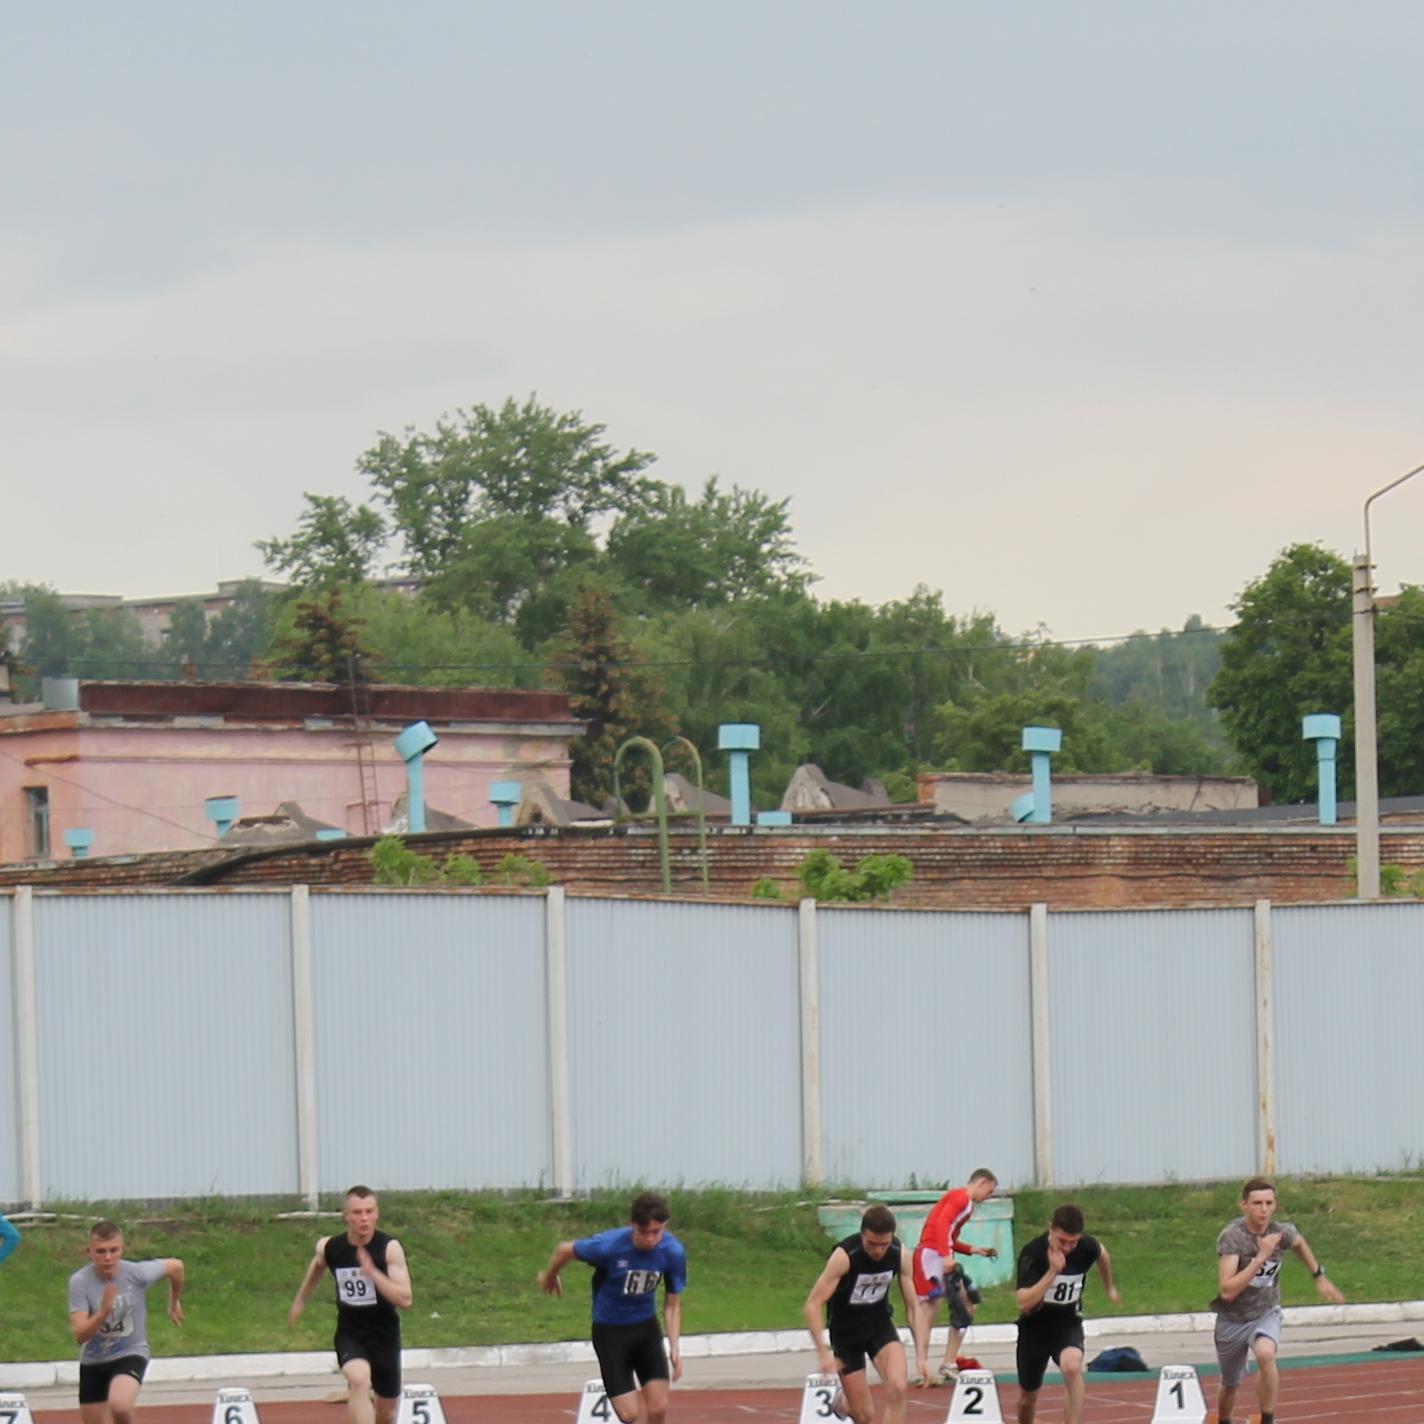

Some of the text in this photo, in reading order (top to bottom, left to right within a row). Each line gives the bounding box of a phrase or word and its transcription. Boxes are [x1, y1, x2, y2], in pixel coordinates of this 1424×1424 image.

[345, 1280, 366, 1297] 99
[861, 1283, 882, 1297] 77
[1054, 1282, 1075, 1301] 81
[591, 1394, 611, 1422] 4
[816, 1389, 833, 1417] 3
[963, 1386, 984, 1415] 2
[1169, 1381, 1184, 1409] 1
